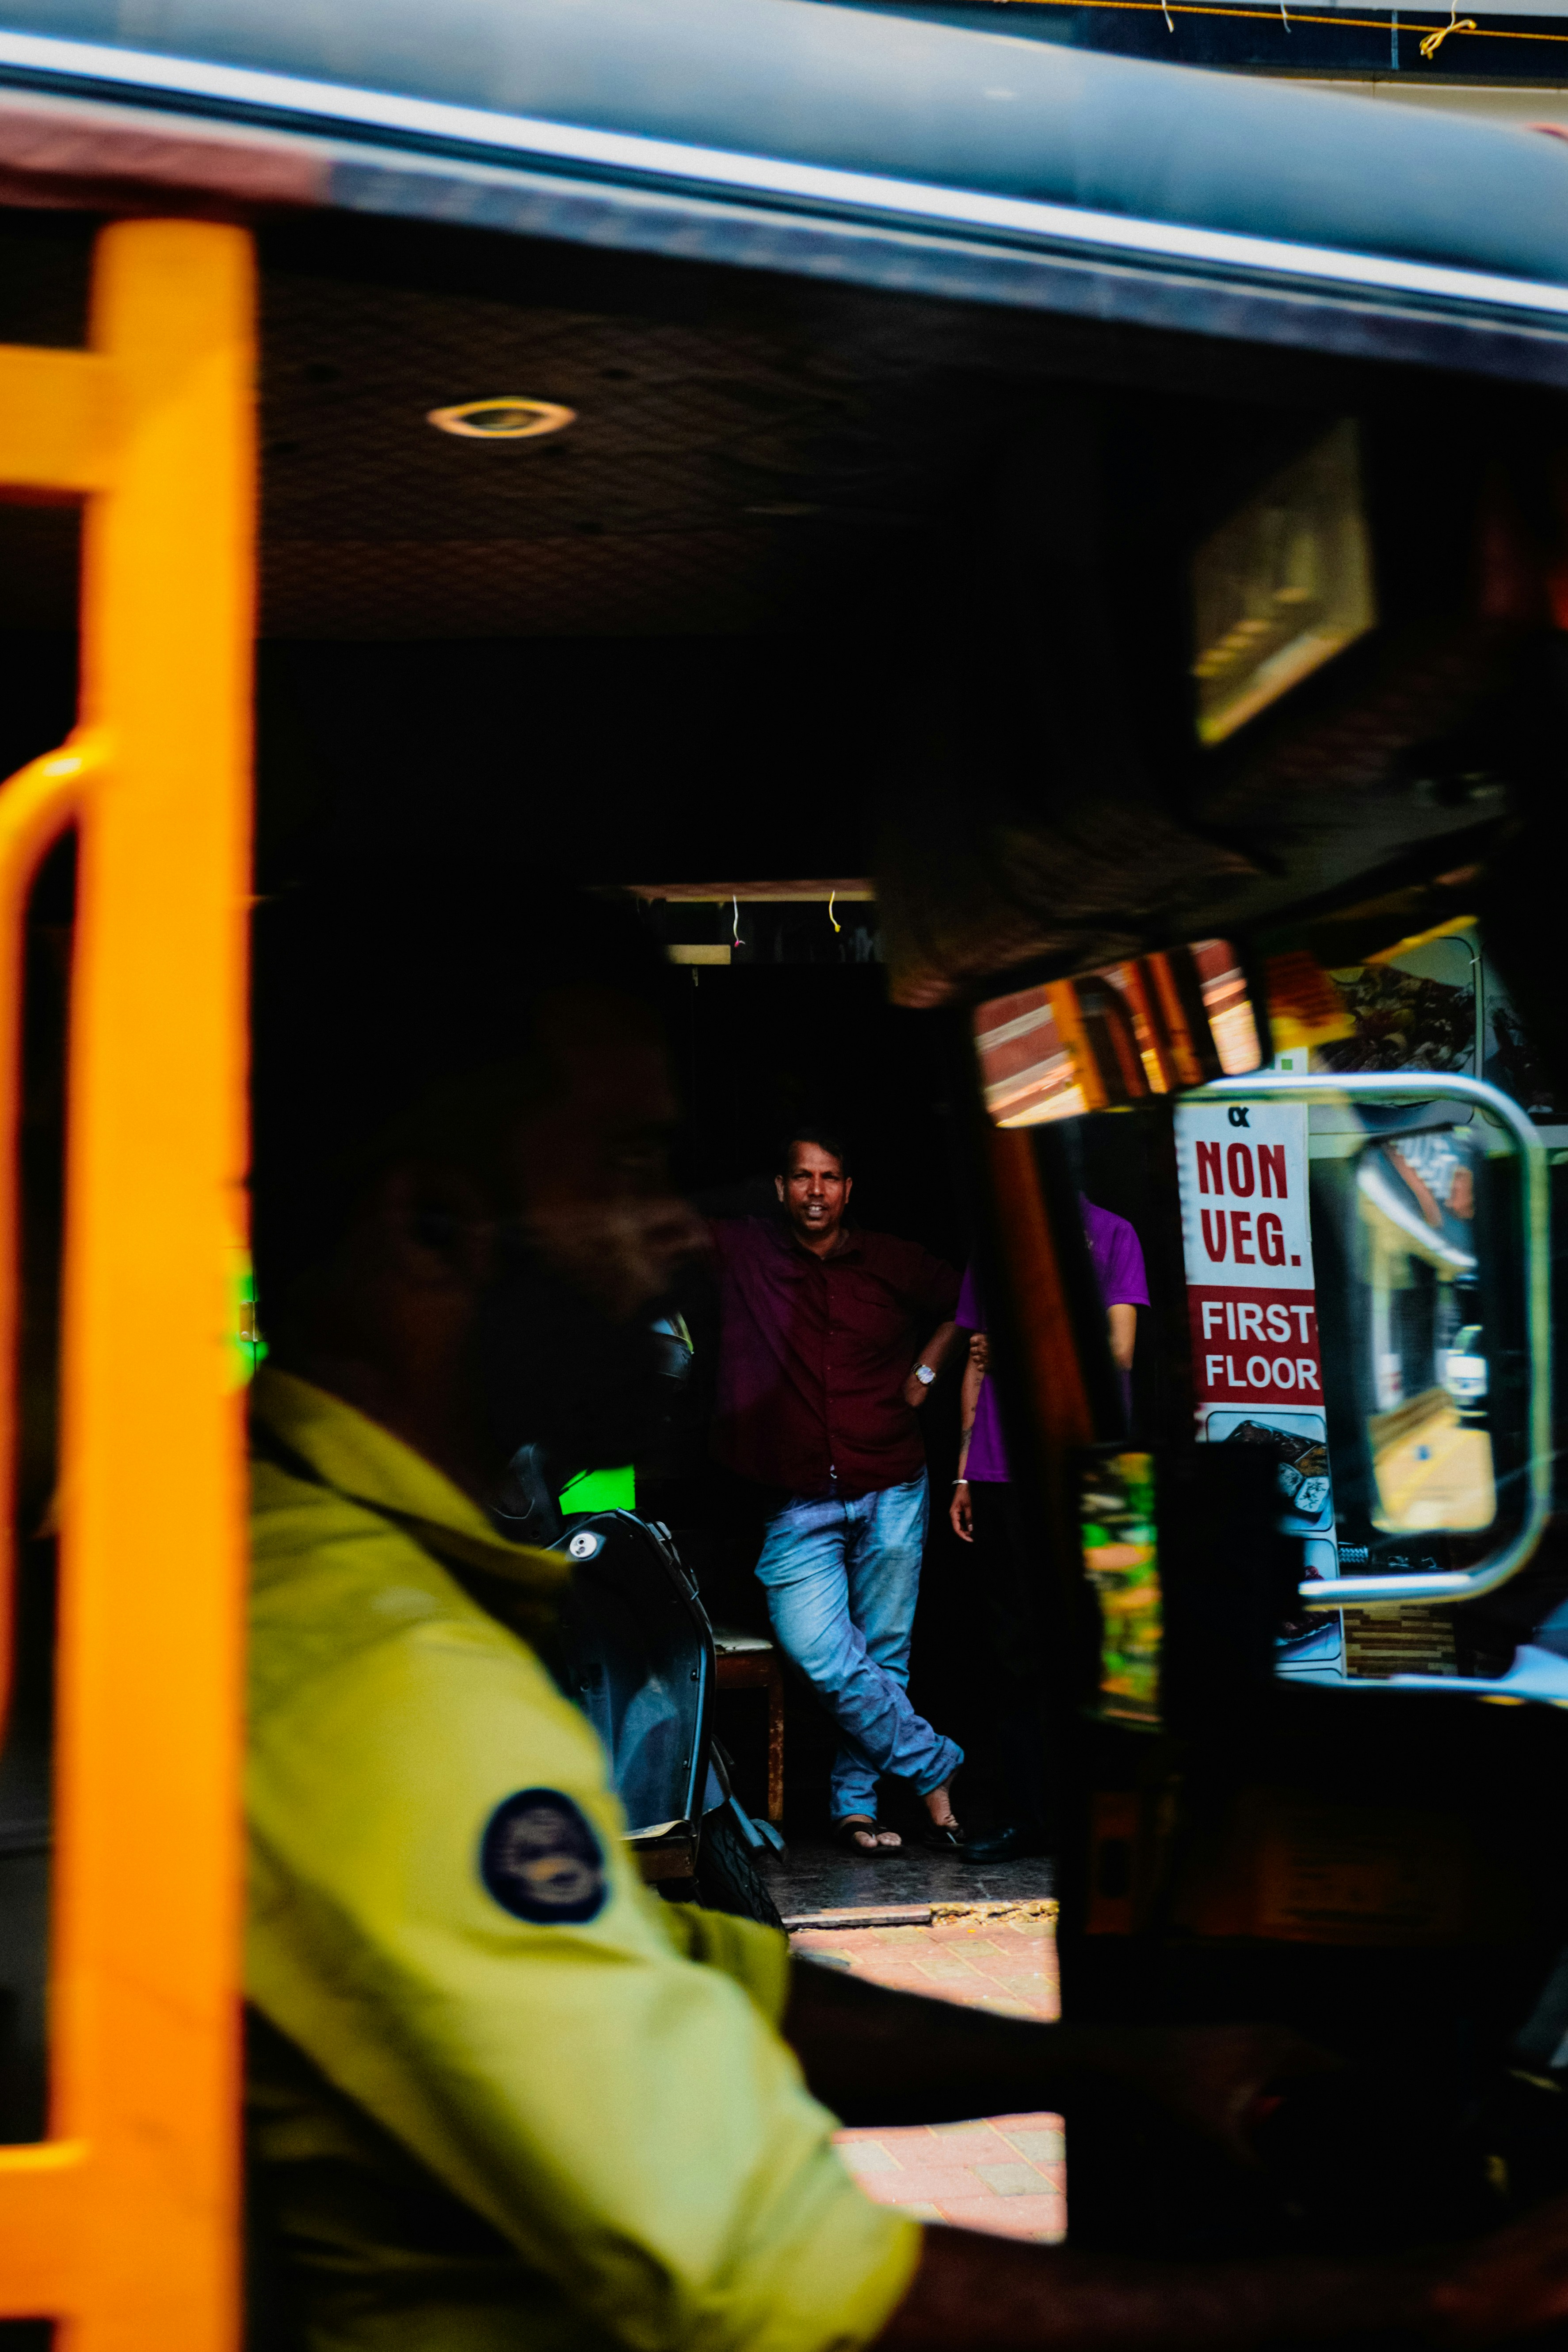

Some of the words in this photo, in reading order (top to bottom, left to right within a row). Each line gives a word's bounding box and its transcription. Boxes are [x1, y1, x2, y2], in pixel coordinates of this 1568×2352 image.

[1196, 1141, 1287, 1198] NON
[1201, 1209, 1301, 1266] VEG.
[1201, 1301, 1315, 1344] FIRST
[1206, 1354, 1321, 1391] FLOOR
